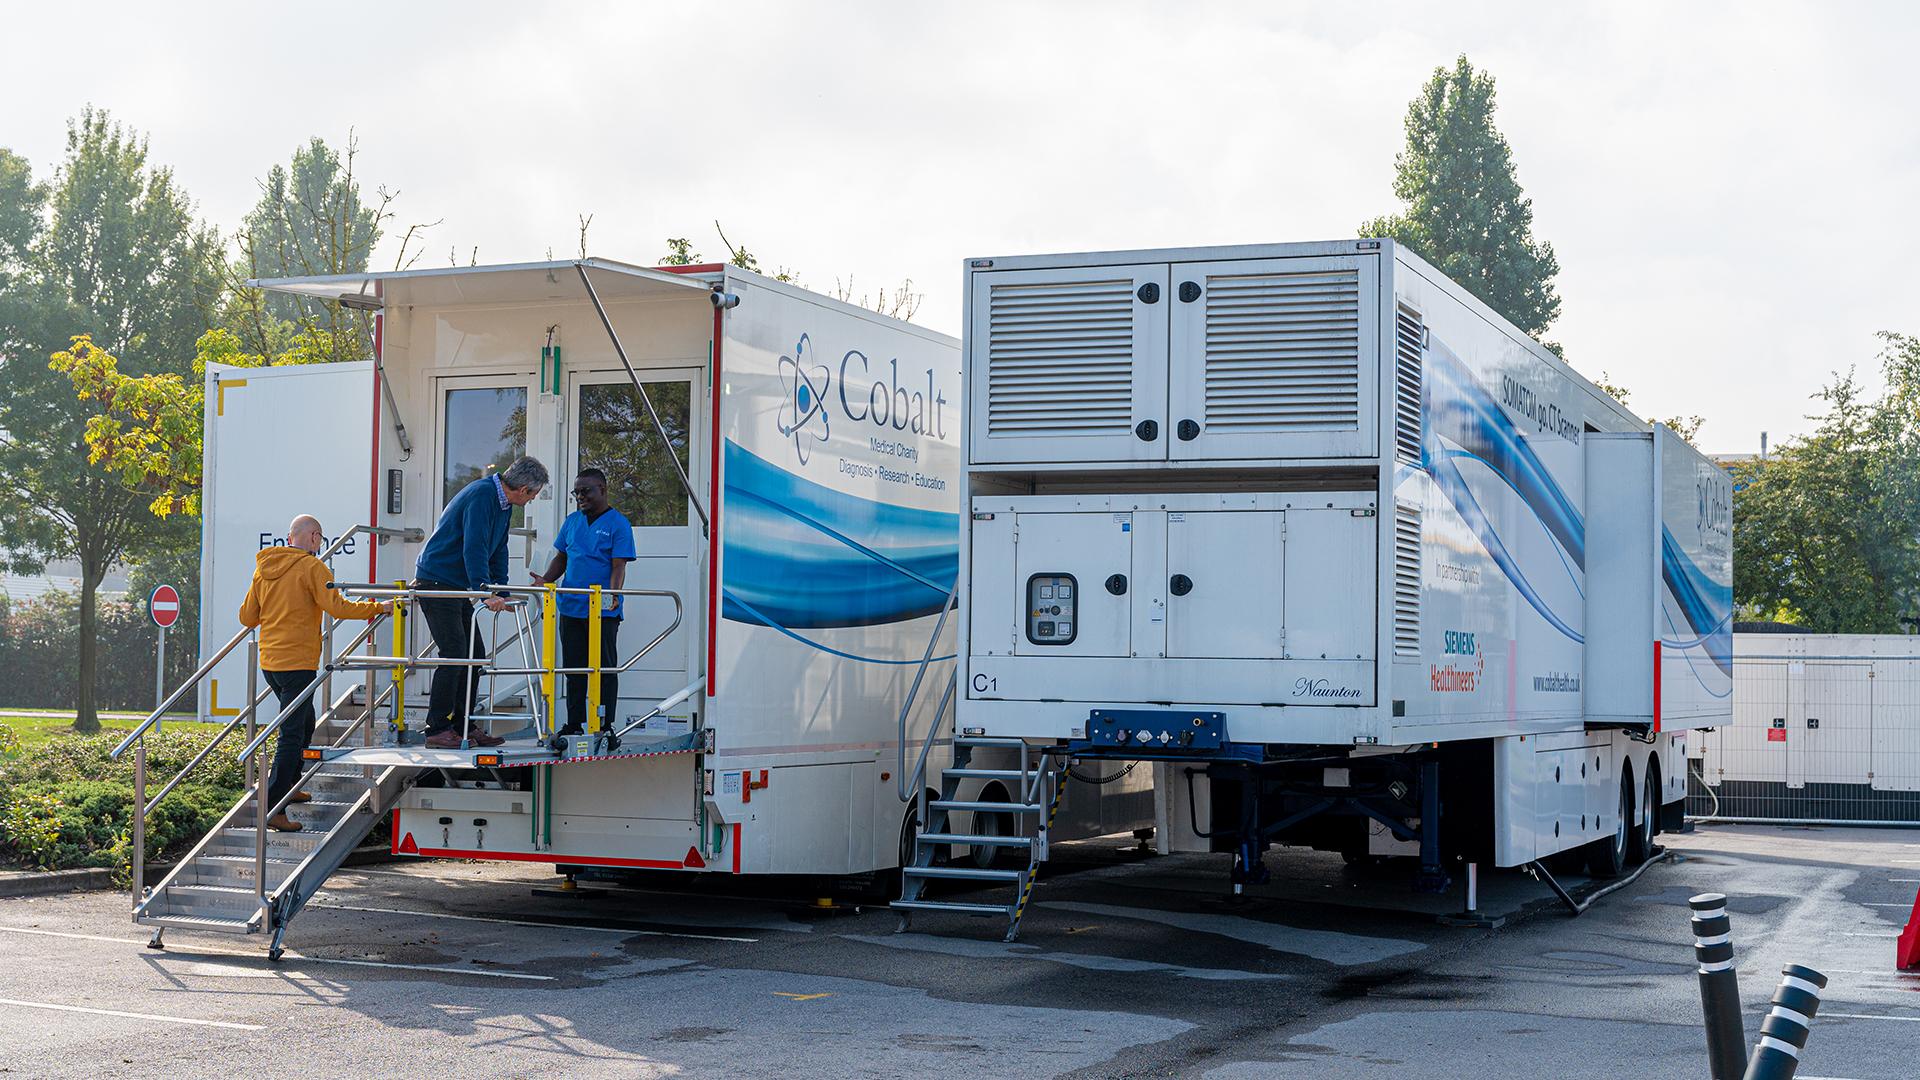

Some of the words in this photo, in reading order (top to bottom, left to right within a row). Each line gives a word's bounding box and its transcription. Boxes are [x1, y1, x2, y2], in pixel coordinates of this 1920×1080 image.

[839, 350, 947, 440] Cobalt
[1503, 374, 1537, 422] SOMATOM
[1549, 403, 1557, 433] CT
[1557, 408, 1579, 446] Scanner
[871, 437, 896, 456] Medical
[897, 442, 919, 464] Charity
[839, 458, 873, 479] Diagnosis
[879, 465, 910, 485] Research
[915, 472, 946, 491] Education
[1444, 630, 1475, 656] SIEMENS
[972, 673, 997, 693] C1
[1292, 677, 1362, 698] Naunton
[1430, 663, 1475, 692] Healthineers
